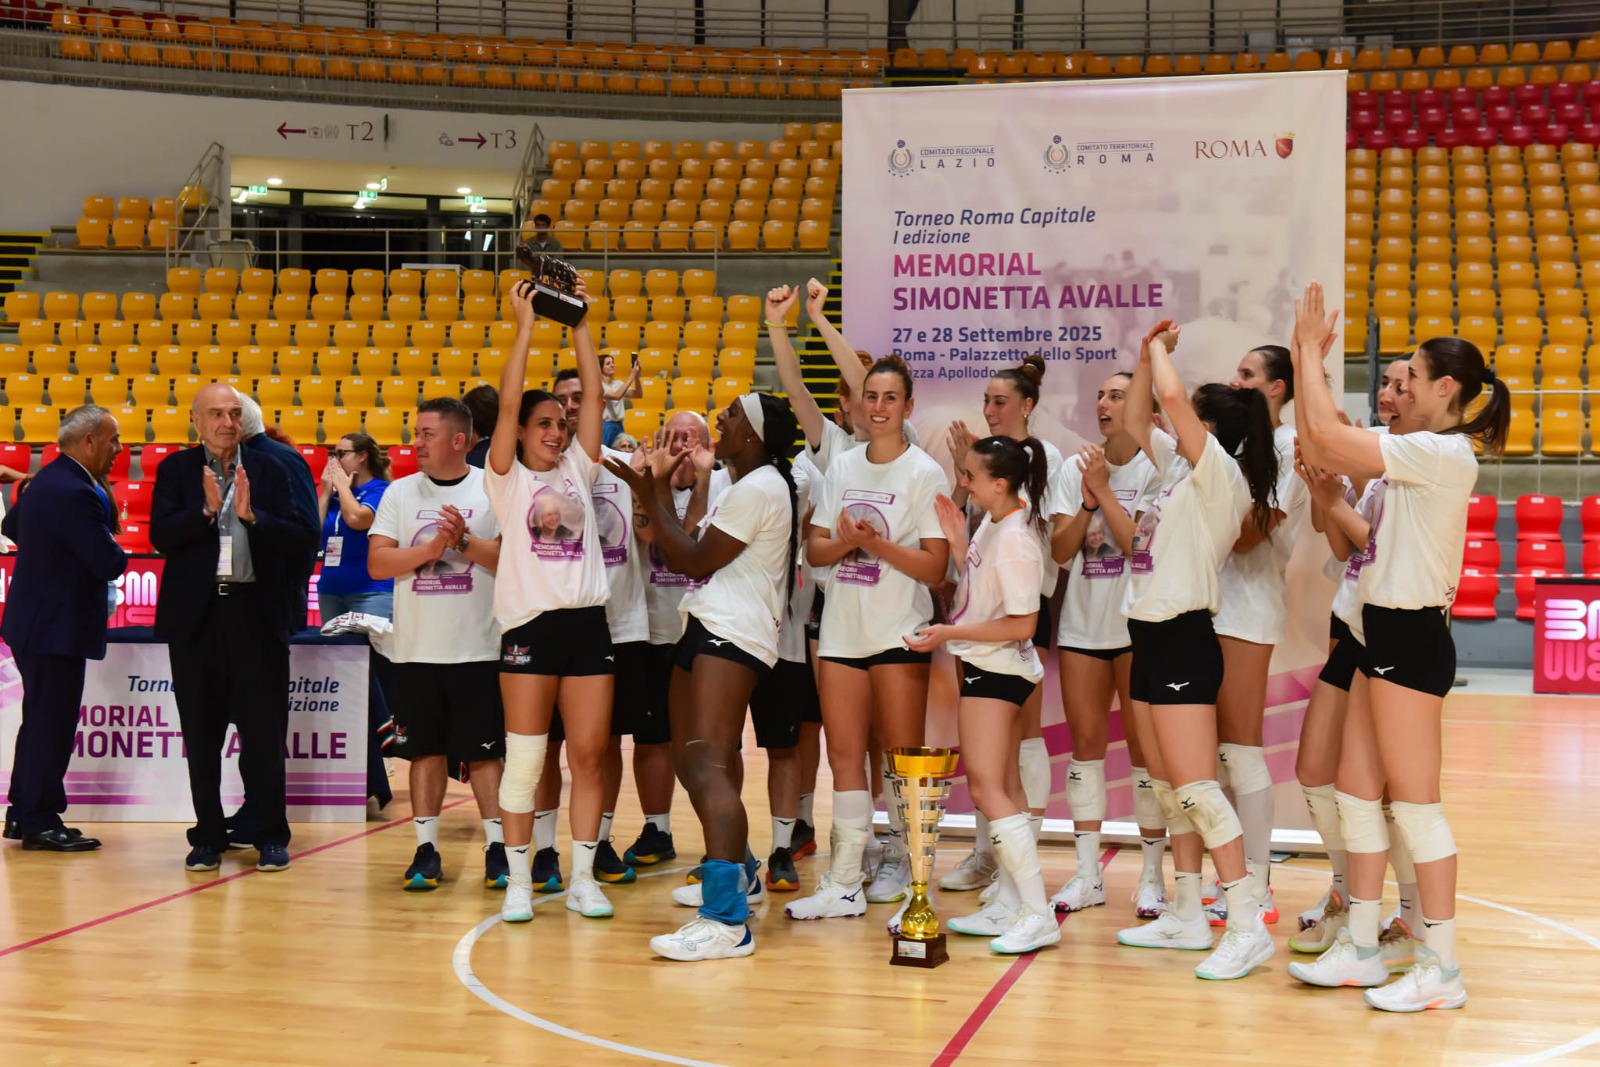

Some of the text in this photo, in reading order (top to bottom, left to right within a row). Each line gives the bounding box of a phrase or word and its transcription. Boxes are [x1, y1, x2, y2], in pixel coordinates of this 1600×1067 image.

[346, 121, 374, 141] T2
[490, 130, 516, 149] T3
[920, 148, 954, 156] COMITATO
[1076, 142, 1154, 151] COMITATO TERRITORIALE
[1195, 139, 1267, 159] ROMA
[894, 206, 1096, 228] Torneo Roma Capitale
[902, 229, 970, 244] edizione
[893, 252, 1041, 277] MEMORIAL
[893, 283, 1163, 311] SIMONETTA AVALLE
[892, 326, 1102, 343] 27 e 28 Settembre 2025
[950, 347, 1028, 361] Palazzetto
[1076, 346, 1117, 363] Sport
[938, 366, 999, 381] Apollodo
[127, 675, 176, 692] Torn
[287, 697, 340, 712] izione
[225, 732, 347, 759] ALLE
